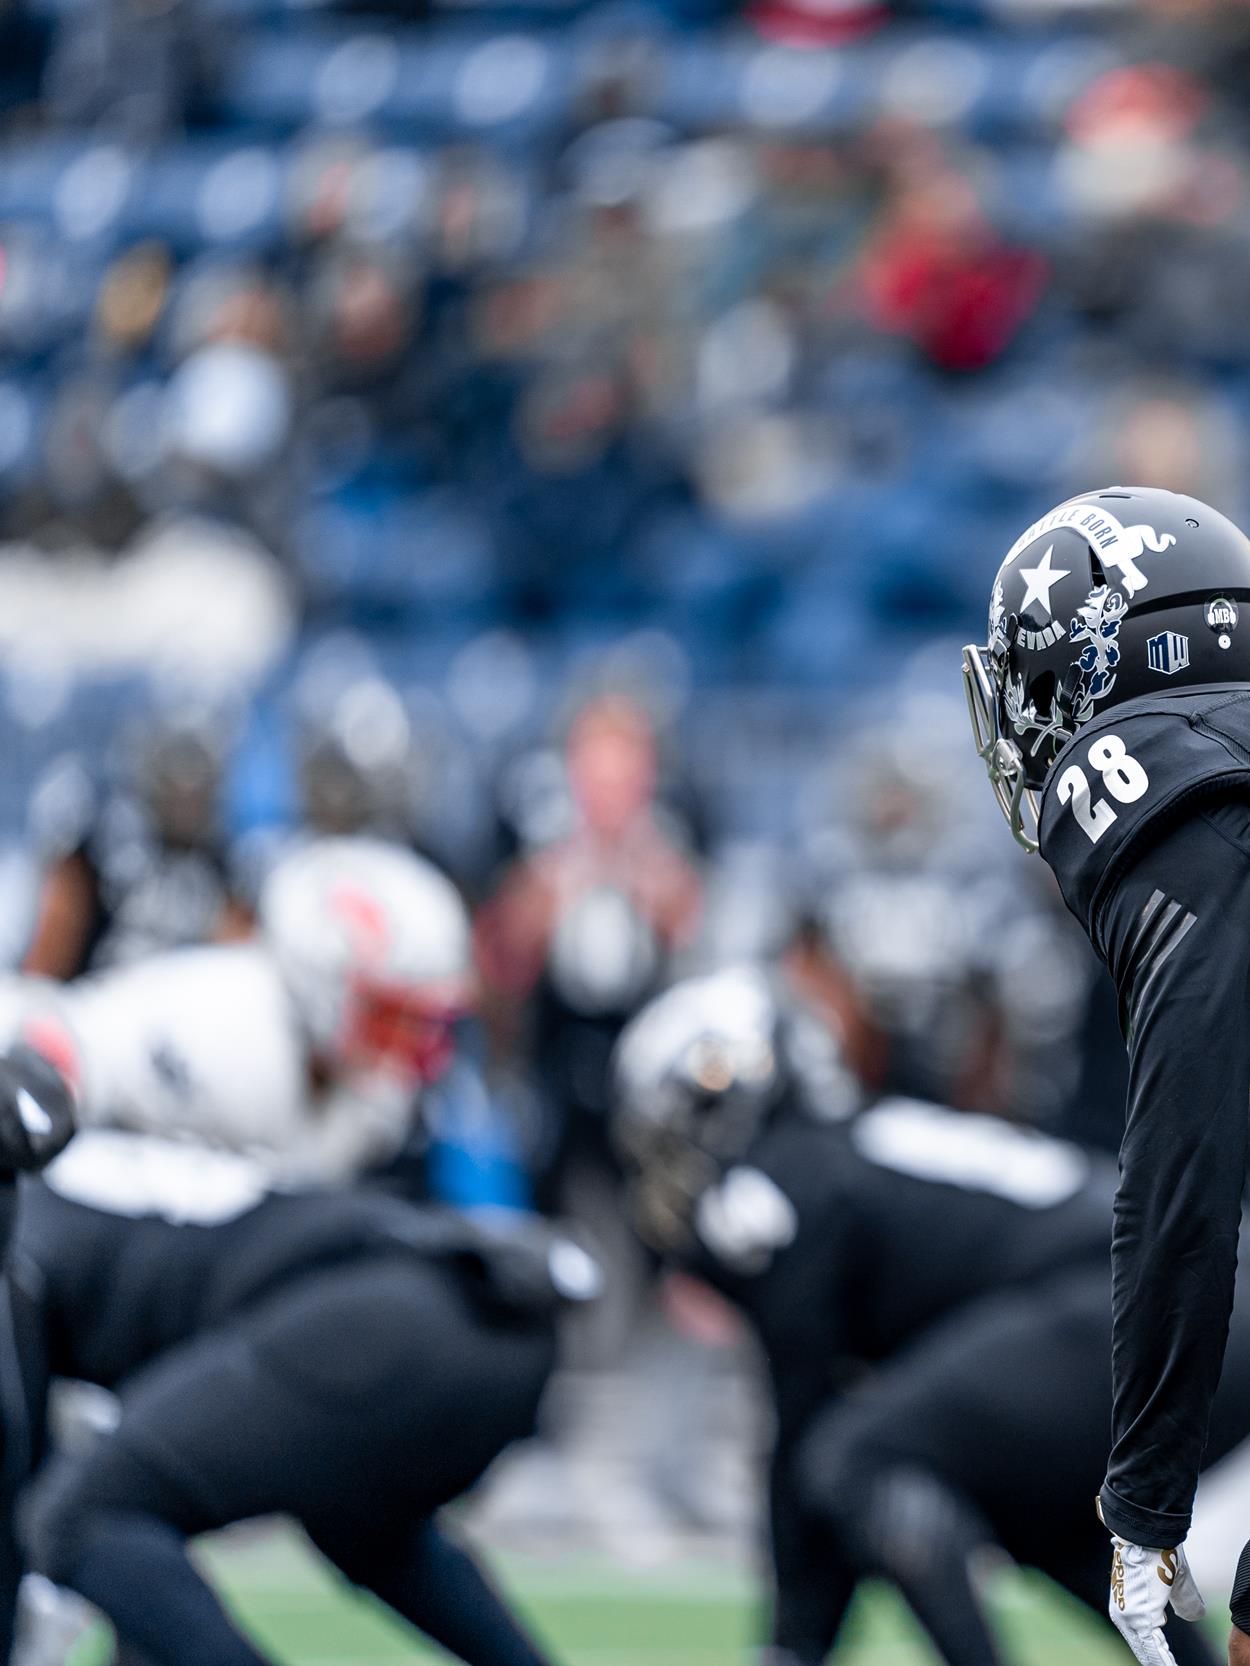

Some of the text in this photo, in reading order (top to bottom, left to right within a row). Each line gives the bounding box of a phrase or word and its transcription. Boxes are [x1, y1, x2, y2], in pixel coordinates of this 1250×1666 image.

[1080, 513, 1118, 549] BORN
[1015, 620, 1066, 651] EVADA
[1214, 608, 1230, 624] MB
[1147, 631, 1190, 675] MW
[1056, 735, 1149, 844] 28
[1115, 1542, 1126, 1612] adida
